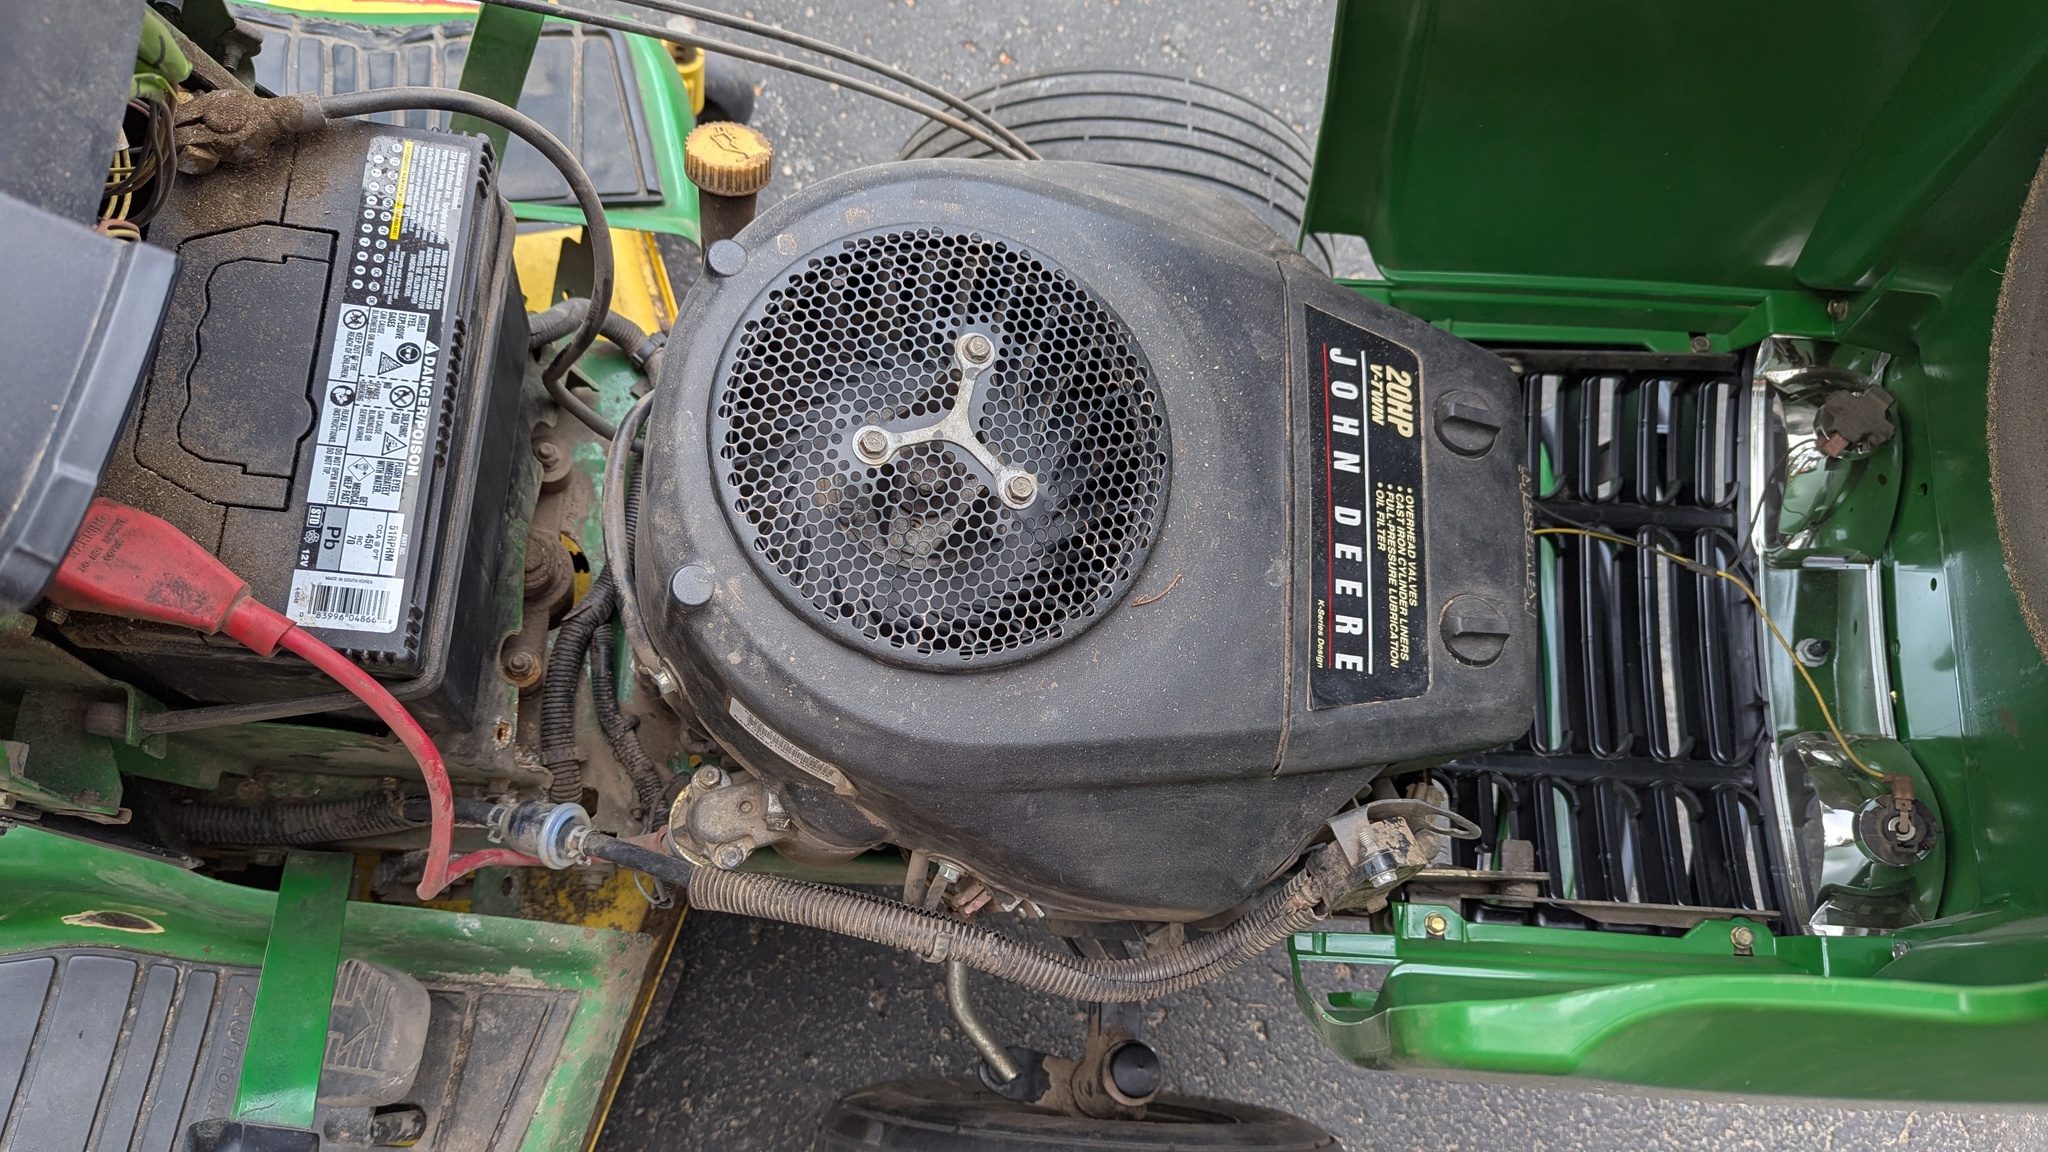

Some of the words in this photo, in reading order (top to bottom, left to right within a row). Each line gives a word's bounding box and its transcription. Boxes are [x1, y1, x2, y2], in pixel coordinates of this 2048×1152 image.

[368, 309, 380, 333] BLINDNESS
[379, 310, 388, 320] CAN
[386, 311, 397, 327] GASES
[406, 313, 417, 328] EYES.
[416, 315, 427, 332] SHIELD
[376, 319, 386, 334] CAUSE
[394, 312, 407, 340] EXPLOSIVE
[345, 330, 355, 347] REACH
[354, 331, 363, 344] KEEP
[352, 344, 361, 354] OUT
[364, 340, 374, 358] INJURY.
[349, 361, 358, 371] THE
[1370, 364, 1385, 426] V-TWIN
[1385, 365, 1414, 438] 20HP
[340, 408, 349, 421] READ
[357, 408, 368, 426] SEVERE
[376, 410, 385, 420] CAN
[389, 411, 400, 424] ACID
[404, 355, 436, 476] DANGER/POISON
[1329, 348, 1361, 473] JOHN
[327, 407, 341, 444] INSTRUCTIONS.
[338, 422, 347, 431] ALL
[365, 409, 376, 434] BLINDNESS
[373, 420, 383, 435] CAUSE
[397, 412, 410, 437] SULFURIC
[354, 426, 364, 443] BURNS.
[363, 434, 372, 442] OR
[334, 447, 342, 455] DO
[323, 455, 332, 465] NOT
[332, 455, 341, 466] NOT
[375, 460, 385, 474] WITH
[322, 465, 330, 475] TIP.
[330, 466, 339, 480] OPEN
[380, 460, 395, 496] IMMEDIATELY
[392, 461, 404, 479] FLUSH
[342, 475, 353, 489] HELP
[371, 474, 383, 495] WATER.
[390, 479, 400, 492] EYES
[326, 481, 336, 503] BATTERY.
[339, 489, 350, 504] FAST.
[349, 482, 361, 505] MEDICAL
[1375, 489, 1385, 507] OIL
[358, 496, 368, 506] GET
[1395, 493, 1405, 524] CAST
[308, 507, 321, 524] STD
[375, 524, 383, 539] CCA
[1376, 510, 1386, 551] FILTER
[1406, 495, 1417, 558] OVERHEAD
[322, 525, 342, 551] Pb
[345, 534, 356, 544] 70
[355, 535, 363, 545] RC
[363, 533, 374, 549] 450
[383, 524, 399, 562] 51RPRM
[400, 533, 408, 546] PART
[1385, 492, 1398, 587] FULL-PRESSURE
[1397, 526, 1406, 556] IRON
[298, 548, 310, 567] 12V
[1334, 505, 1363, 672] DEERE
[1398, 558, 1408, 617] CYLINDER
[1408, 562, 1418, 607] VALVES
[315, 612, 344, 621] 83996
[348, 615, 377, 624] 04866
[1388, 589, 1399, 669] LUBRICATION
[1399, 619, 1410, 661] LINERS
[1317, 637, 1325, 668] Design
[203, 984, 255, 1121] AUTOM
